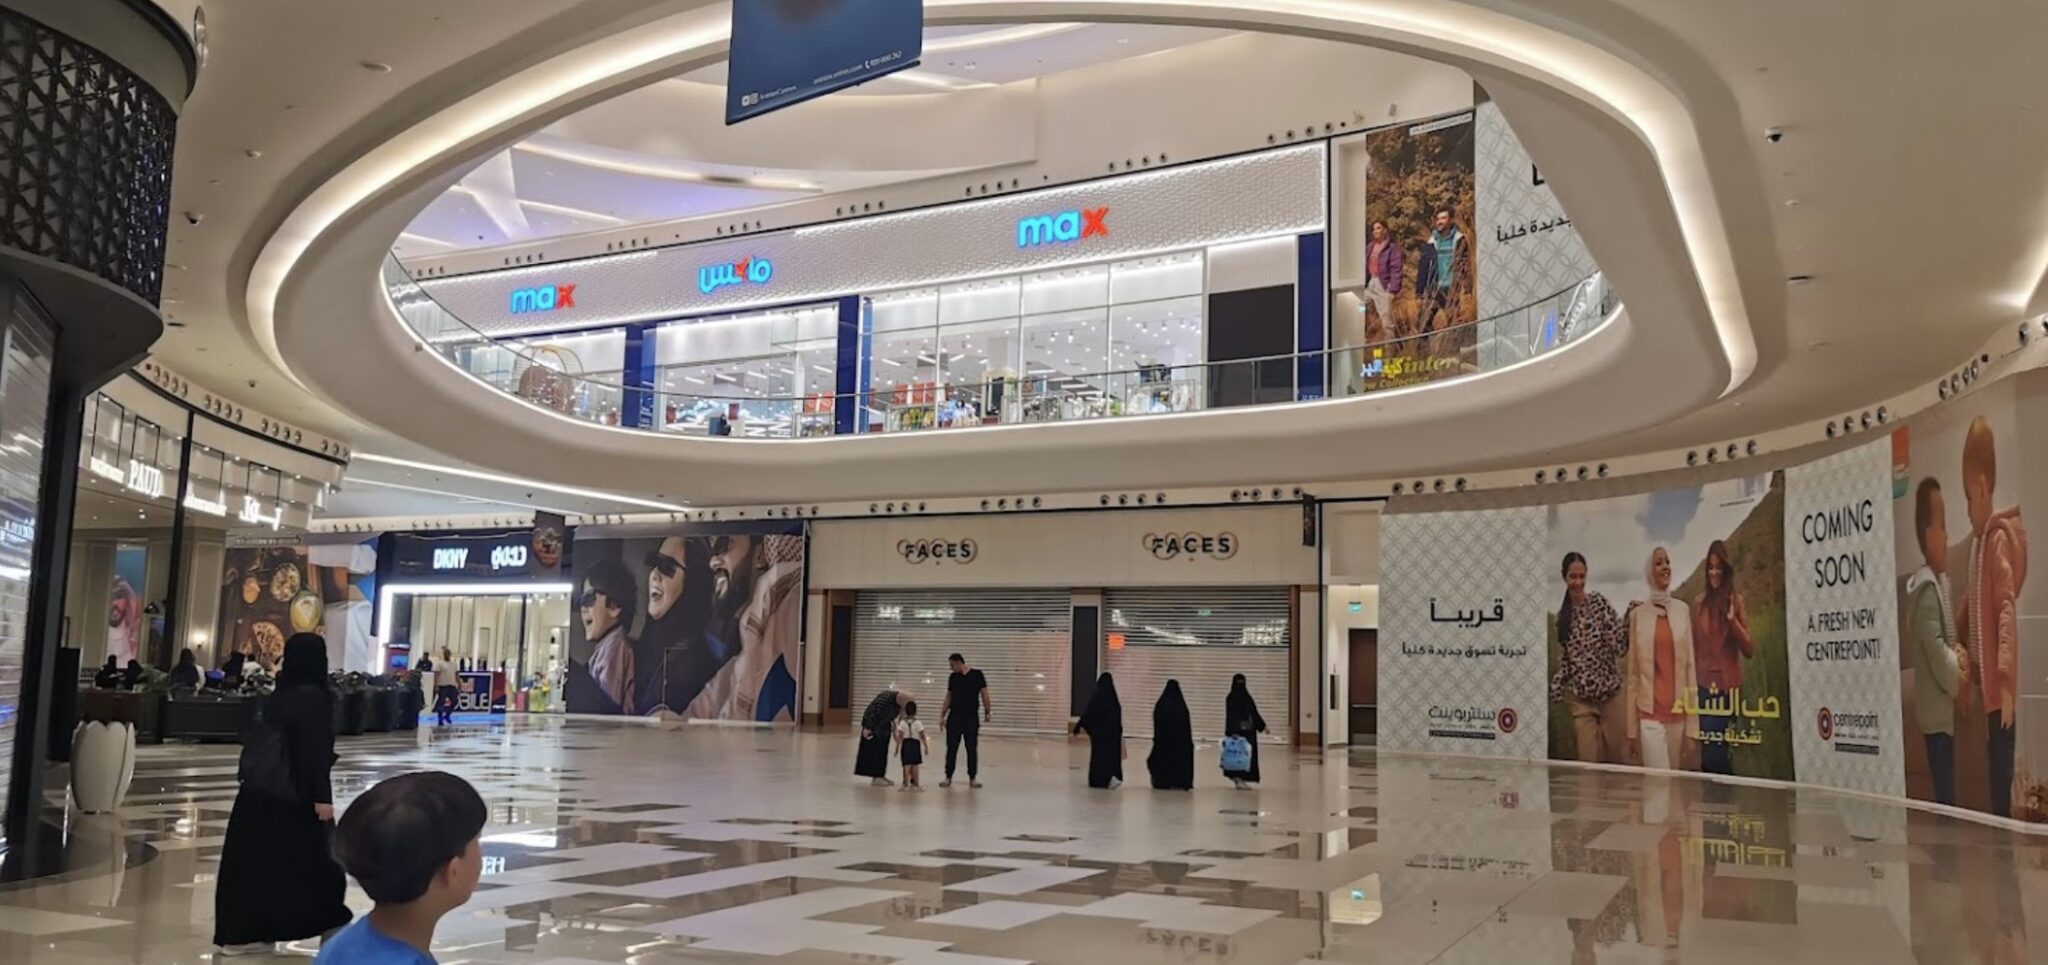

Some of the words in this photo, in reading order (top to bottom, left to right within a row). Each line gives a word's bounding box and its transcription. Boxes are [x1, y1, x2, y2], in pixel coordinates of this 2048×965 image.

[1018, 207, 1109, 248] max
[700, 257, 773, 294] ماكس
[511, 283, 576, 313] max
[1802, 499, 1873, 544] COMING
[905, 543, 971, 558] FACES
[1153, 537, 1231, 553] FACES
[433, 548, 469, 569] DKNY
[1815, 551, 1865, 588] SOON
[1430, 598, 1504, 628] قريباً
[1807, 614, 1816, 632] A
[1818, 611, 1850, 632] FRESH
[1852, 608, 1876, 630] NEW
[1428, 645, 1462, 658] جديدة
[1465, 646, 1496, 658] تسوق
[1498, 645, 1527, 658] تجربة
[1806, 638, 1880, 661] CENTREPOINT!
[1671, 681, 1740, 716] الشتاء
[1428, 705, 1496, 722] سنتربوينت
[1742, 695, 1780, 726] حب
[1834, 711, 1878, 730] centrepoint
[1725, 727, 1762, 747] تشكيلة
